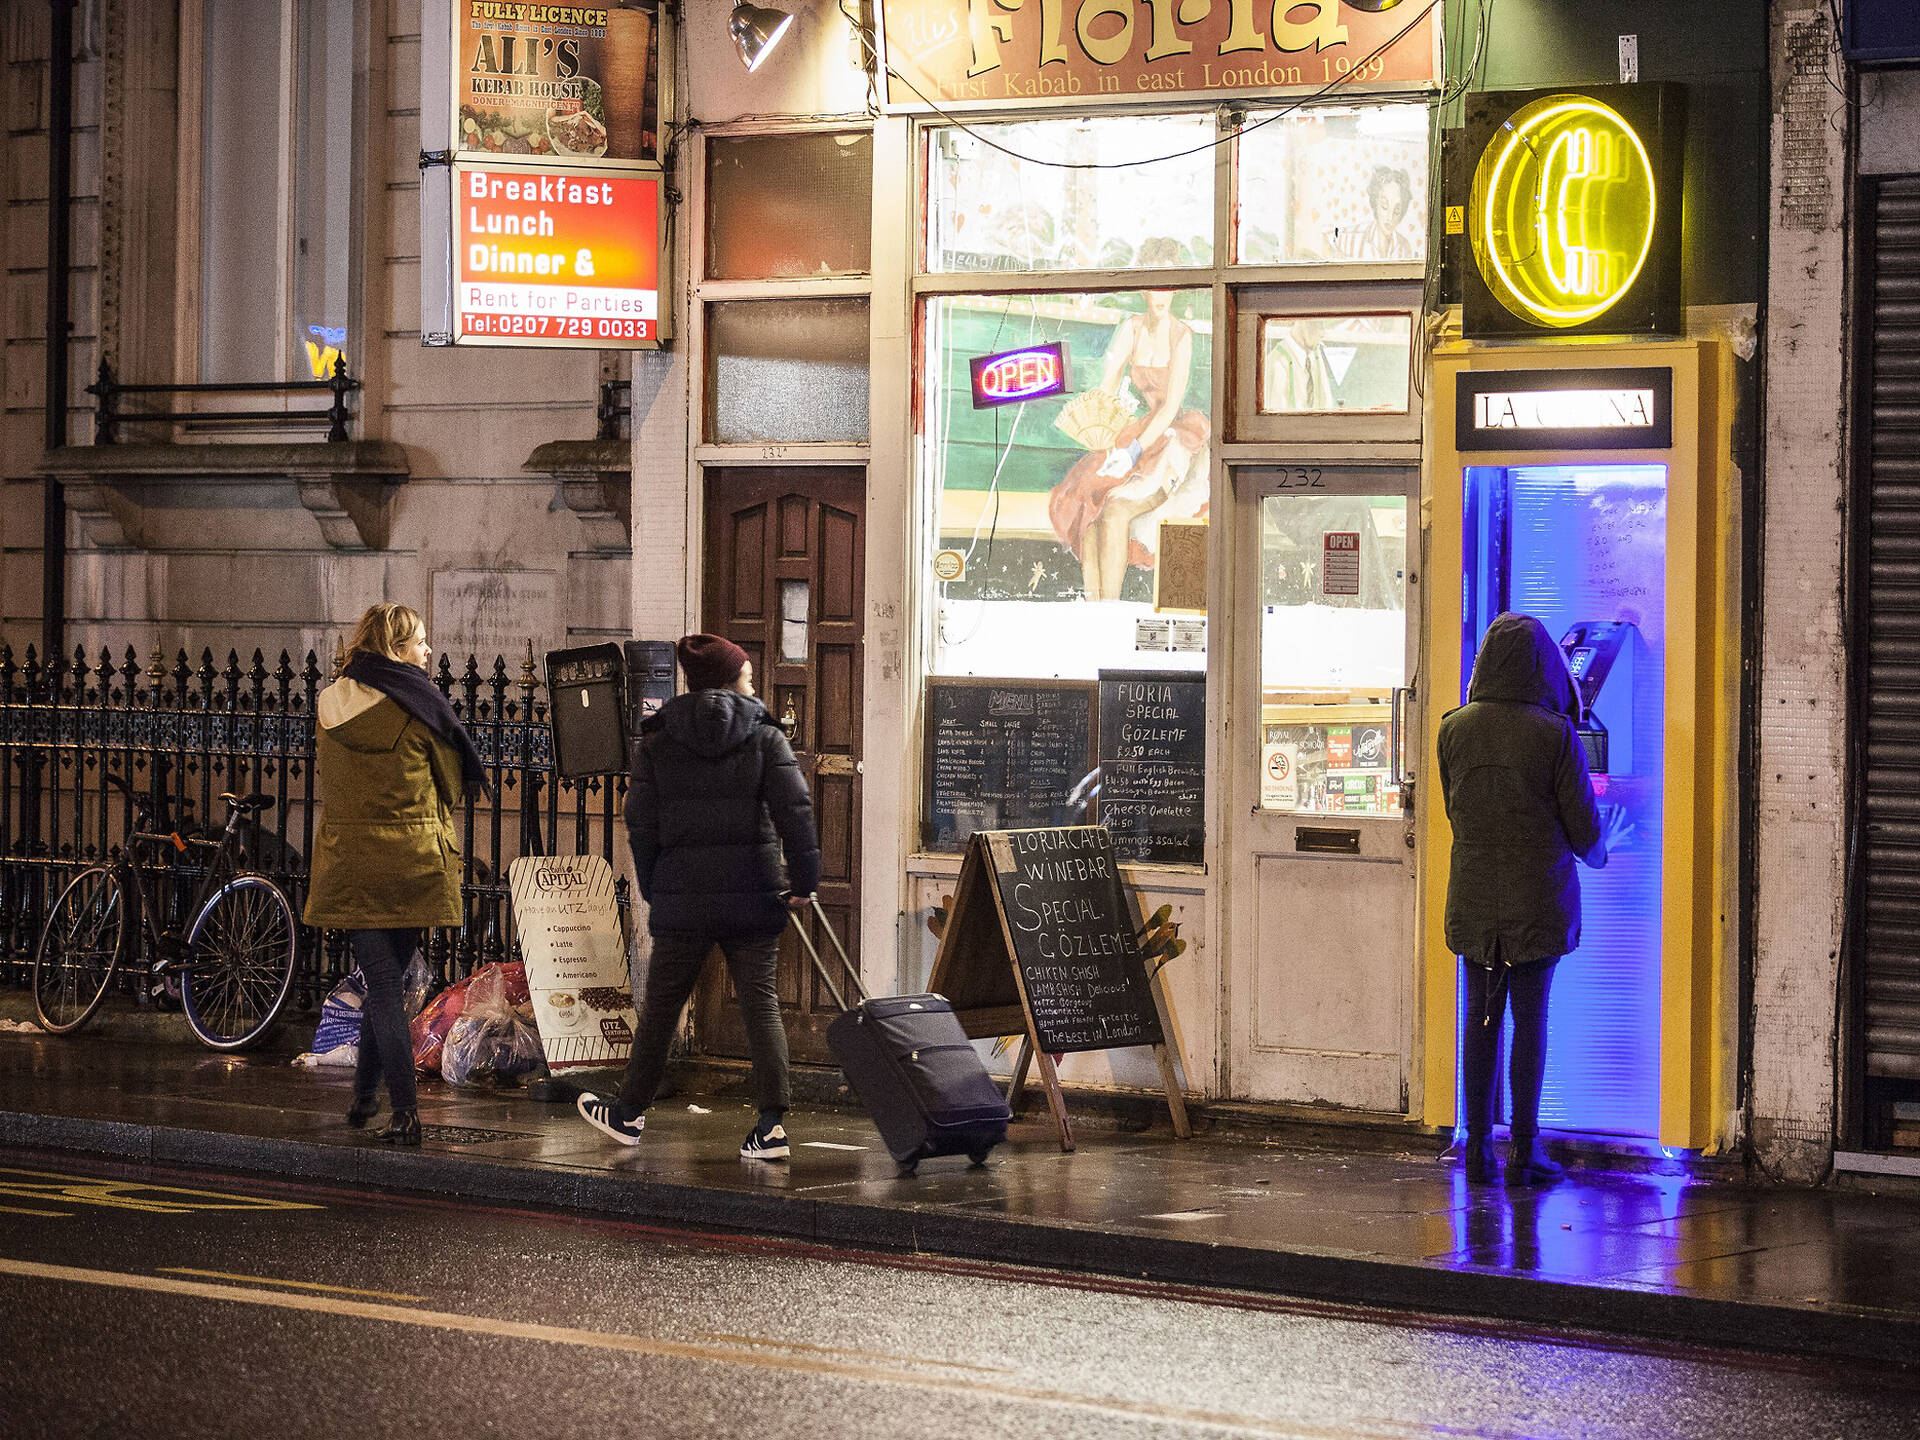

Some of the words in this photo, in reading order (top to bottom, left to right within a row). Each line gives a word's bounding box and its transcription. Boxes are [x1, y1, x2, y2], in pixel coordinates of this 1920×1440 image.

[471, 1, 527, 20] FULLY
[528, 4, 608, 27] LICENCE
[471, 34, 580, 79] ALI'S
[936, 78, 988, 99] First
[1002, 70, 1081, 97] Kabab
[1098, 68, 1120, 92] in
[1136, 68, 1185, 90] east
[1202, 60, 1303, 88] London
[1321, 55, 1385, 84] 1969
[472, 78, 524, 95] KEBAB
[528, 80, 580, 99] HOUSE
[470, 172, 613, 206] Breakfast
[470, 206, 554, 237] Lunch
[469, 243, 565, 275] Dinner
[574, 248, 595, 276] &
[470, 288, 518, 308] Rent
[528, 290, 556, 309] for
[566, 291, 643, 313] Parties
[556, 318, 592, 336] 729
[598, 319, 647, 338] 0033
[982, 357, 1056, 394] OPEN
[1484, 396, 1518, 427] LA
[1276, 468, 1326, 488] 232
[1330, 535, 1354, 549] OPEN
[1118, 684, 1172, 702] FLORIA
[1126, 704, 1179, 719] SPECIAL
[1104, 803, 1147, 816] Cheese
[1149, 805, 1192, 817] Omelette
[536, 868, 587, 892] CAPITAL
[558, 902, 587, 914] UTZ
[553, 925, 592, 933] Cappuccino
[558, 956, 588, 964] Espresso
[602, 1021, 620, 1030] UTZ
